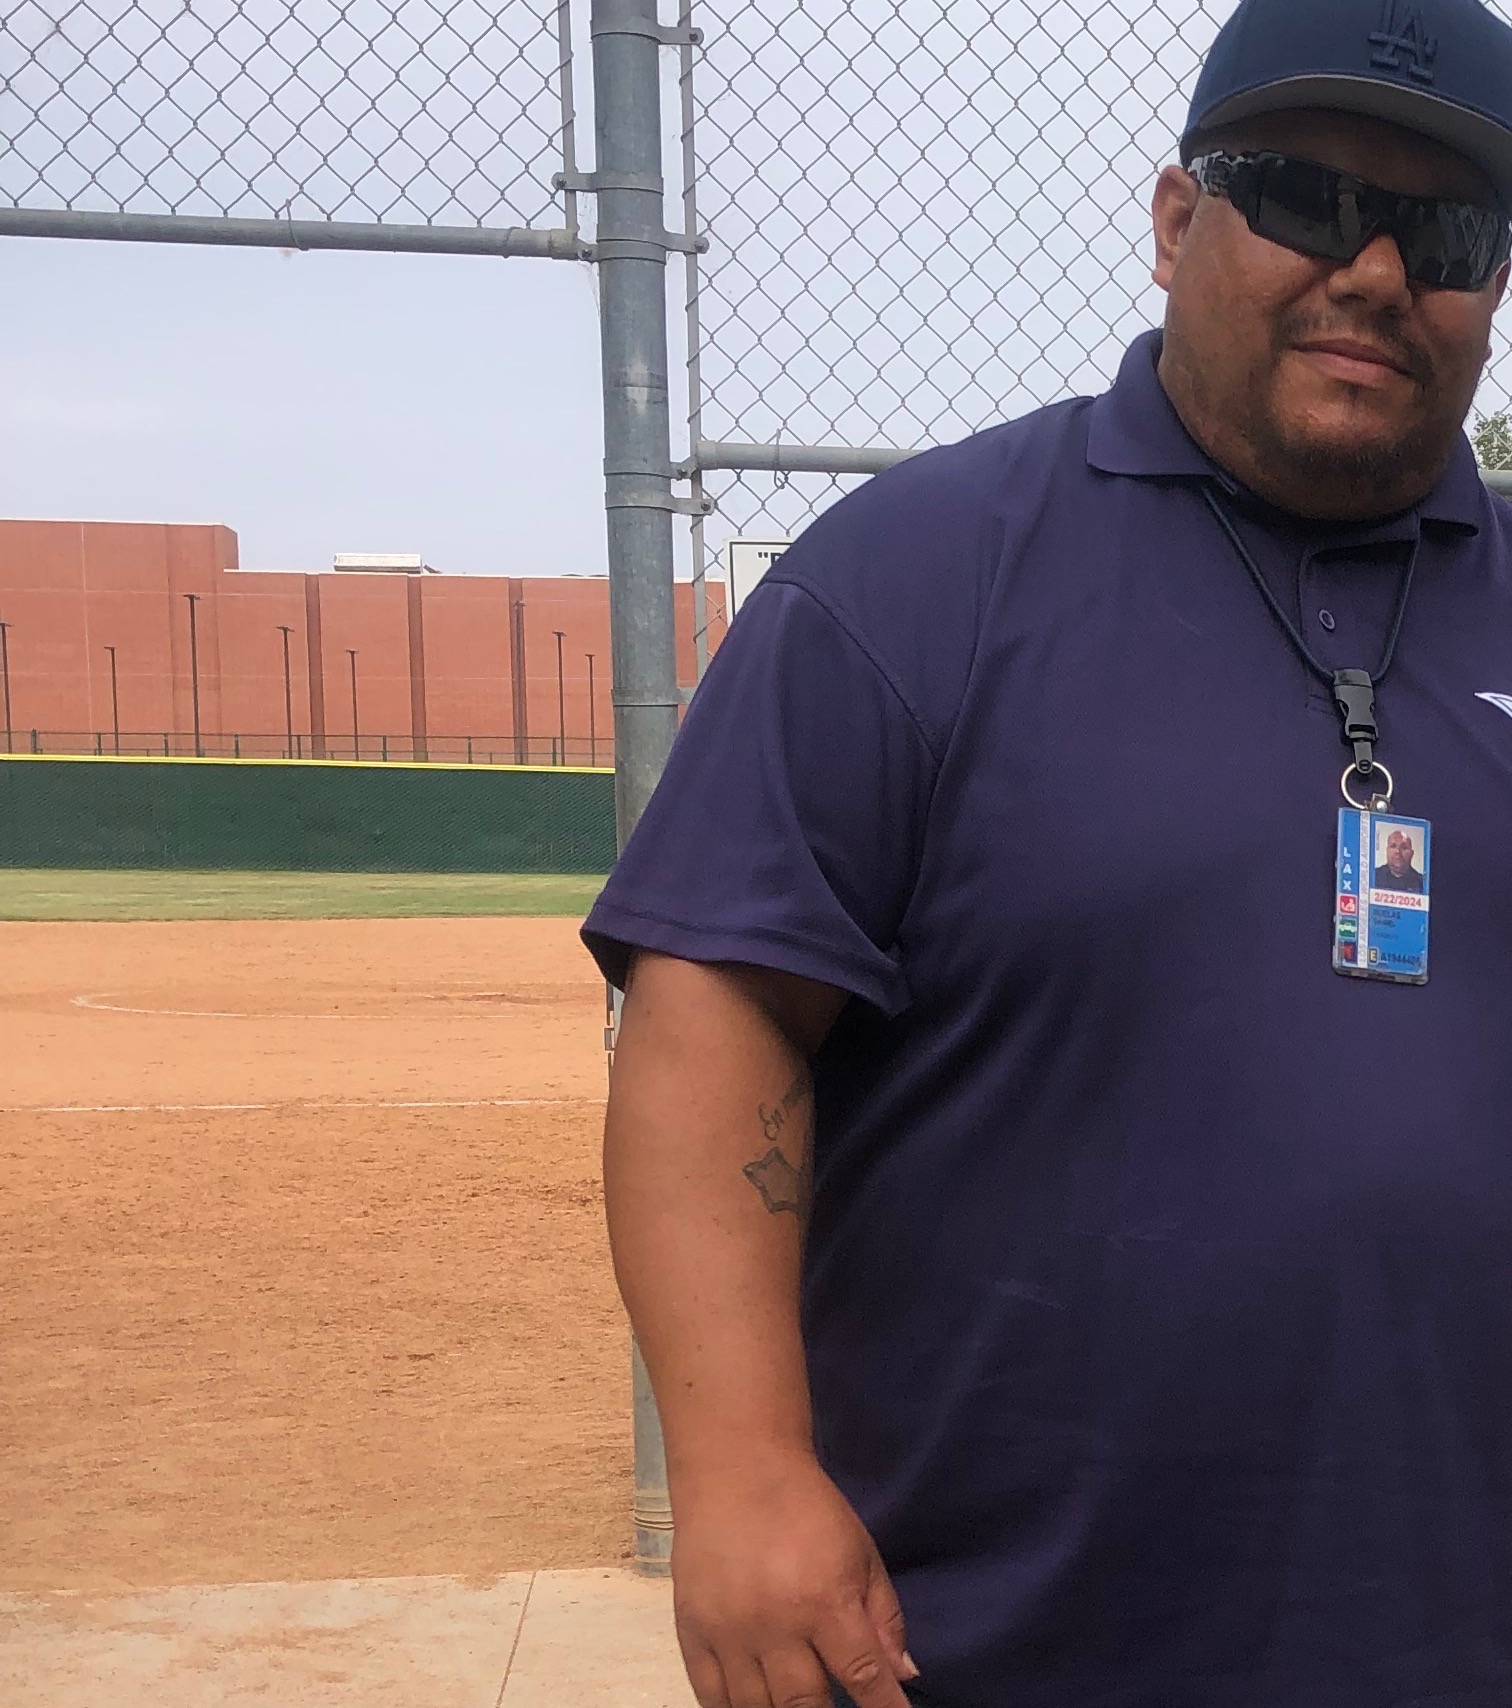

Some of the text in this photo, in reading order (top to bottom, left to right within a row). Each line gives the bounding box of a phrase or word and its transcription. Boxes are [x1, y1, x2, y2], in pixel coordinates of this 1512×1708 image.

[1366, 0, 1438, 84] LA
[1342, 846, 1353, 890] LAX
[1374, 892, 1422, 907] 2/22/2024
